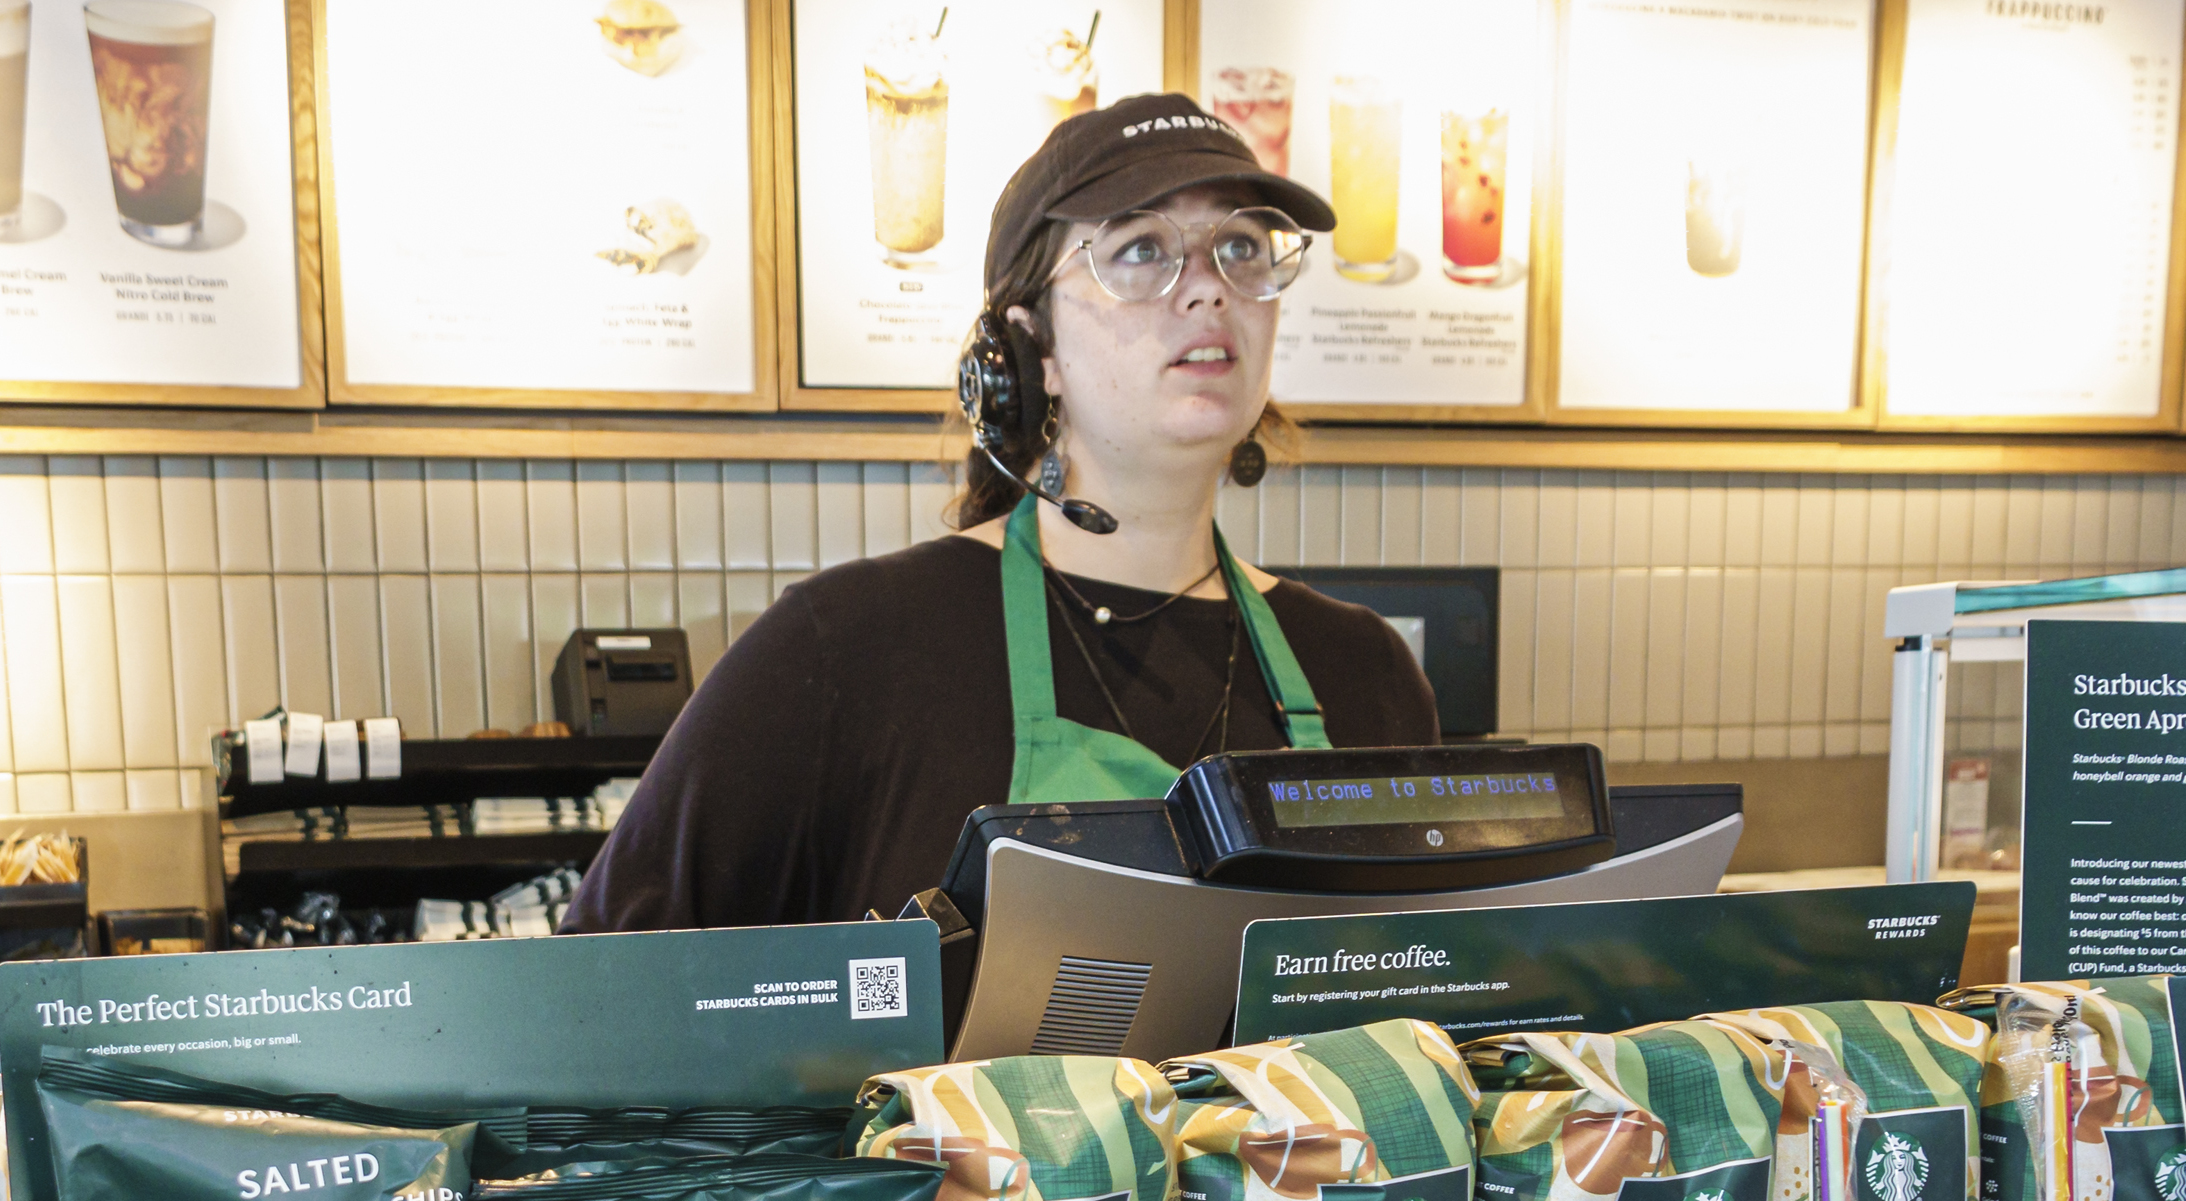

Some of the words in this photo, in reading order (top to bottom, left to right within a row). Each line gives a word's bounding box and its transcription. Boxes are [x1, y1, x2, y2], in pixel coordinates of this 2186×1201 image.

[1123, 115, 1245, 142] STARBU
[100, 272, 143, 285] Vanilla
[146, 273, 183, 287] Sweet
[188, 275, 228, 289] Cream
[116, 289, 149, 301] Nitro
[152, 290, 180, 302] Cold
[183, 291, 215, 304] Brew
[2073, 673, 2186, 696] Starbucks
[2073, 708, 2142, 730] Green
[2127, 754, 2163, 764] Blonde
[2072, 770, 2124, 783] honeybell
[2125, 773, 2161, 784] orange
[2161, 771, 2183, 782] and
[1268, 780, 1373, 802] Welcome
[1390, 777, 1415, 798] to
[1431, 774, 1556, 797] Starbucks
[2070, 858, 2130, 871] Introducing
[2131, 860, 2149, 869] our
[2150, 860, 2186, 869] newest
[2070, 877, 2100, 886] cause
[2102, 875, 2117, 886] for
[2119, 876, 2180, 886] celebration.
[2108, 895, 2129, 903] was
[2130, 894, 2170, 903] created
[2171, 894, 2184, 906] by
[2069, 910, 2098, 920] know
[2100, 912, 2117, 920] our
[2119, 910, 2152, 920] coffee
[2153, 911, 2180, 920] best:
[1874, 928, 1926, 940] REWARDS
[2069, 928, 2078, 937] is
[2080, 928, 2139, 940] designating
[2141, 928, 2151, 938] $5
[2153, 928, 2178, 938] from
[2068, 945, 2081, 955] of
[2081, 945, 2101, 955] this
[2103, 945, 2136, 955] coffee
[2137, 946, 2149, 955] to
[2150, 947, 2169, 955] our
[1274, 954, 1328, 976] Earn
[1332, 948, 1376, 972] free
[1380, 945, 1451, 969] coffee.
[2068, 962, 2098, 974] (CUP)
[2099, 963, 2128, 974] Fund,
[2137, 963, 2186, 973] Starbucks
[753, 983, 783, 994] SCAN
[784, 982, 799, 992] TO
[801, 980, 837, 991] ORDER
[1272, 993, 1295, 1003] Start
[1296, 992, 1308, 1004] by
[1309, 989, 1358, 1003] registering
[1360, 989, 1380, 1000] your
[1381, 986, 1397, 999] gift
[1398, 985, 1419, 996] card
[1420, 985, 1429, 994] in
[1430, 983, 1446, 993] the
[1447, 981, 1490, 993] Starbucks
[1491, 981, 1510, 992] app.
[36, 999, 94, 1027] The
[99, 994, 200, 1024] Perfect
[205, 986, 343, 1018] Starbucks
[348, 981, 413, 1008] Card
[696, 997, 759, 1010] STARBUCKS
[760, 995, 796, 1007] CARDS
[797, 994, 809, 1004] IN
[810, 993, 838, 1003] BULK
[1509, 1018, 1518, 1026] for
[1534, 1016, 1549, 1024] rates
[1550, 1015, 1562, 1023] and
[143, 1043, 175, 1054] every
[178, 1038, 232, 1051] occasion,
[234, 1036, 252, 1049] big
[254, 1036, 266, 1046] or
[268, 1033, 302, 1045] small.
[1983, 1133, 2008, 1144] COFFEE
[237, 1153, 380, 1199] SALTED
[1182, 1190, 1207, 1201] COFFEE
[1483, 1182, 1515, 1195] COFFEE
